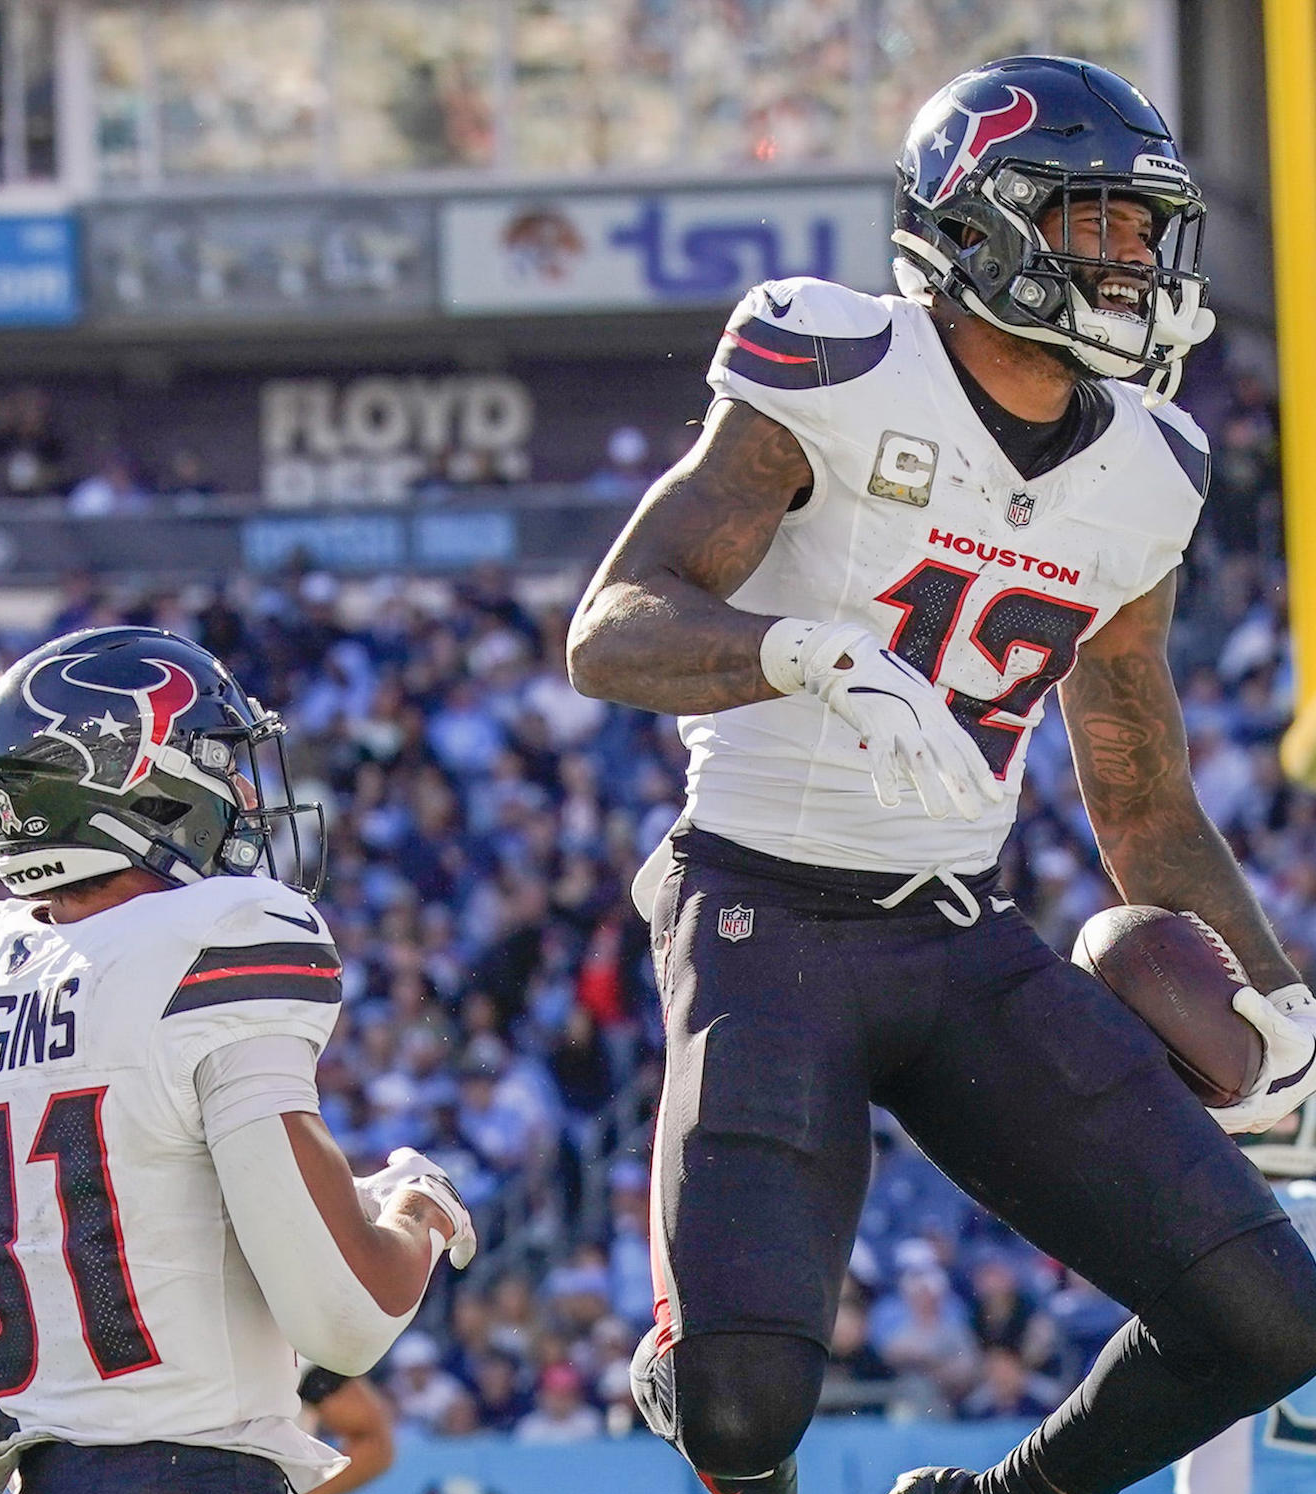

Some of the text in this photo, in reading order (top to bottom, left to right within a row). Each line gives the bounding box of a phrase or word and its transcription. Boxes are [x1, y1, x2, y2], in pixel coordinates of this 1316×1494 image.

[261, 382, 532, 450] FLOYD
[879, 436, 935, 488] C
[928, 527, 1081, 585] HOUSTON
[864, 557, 1100, 782] 12
[724, 920, 747, 934] NFL
